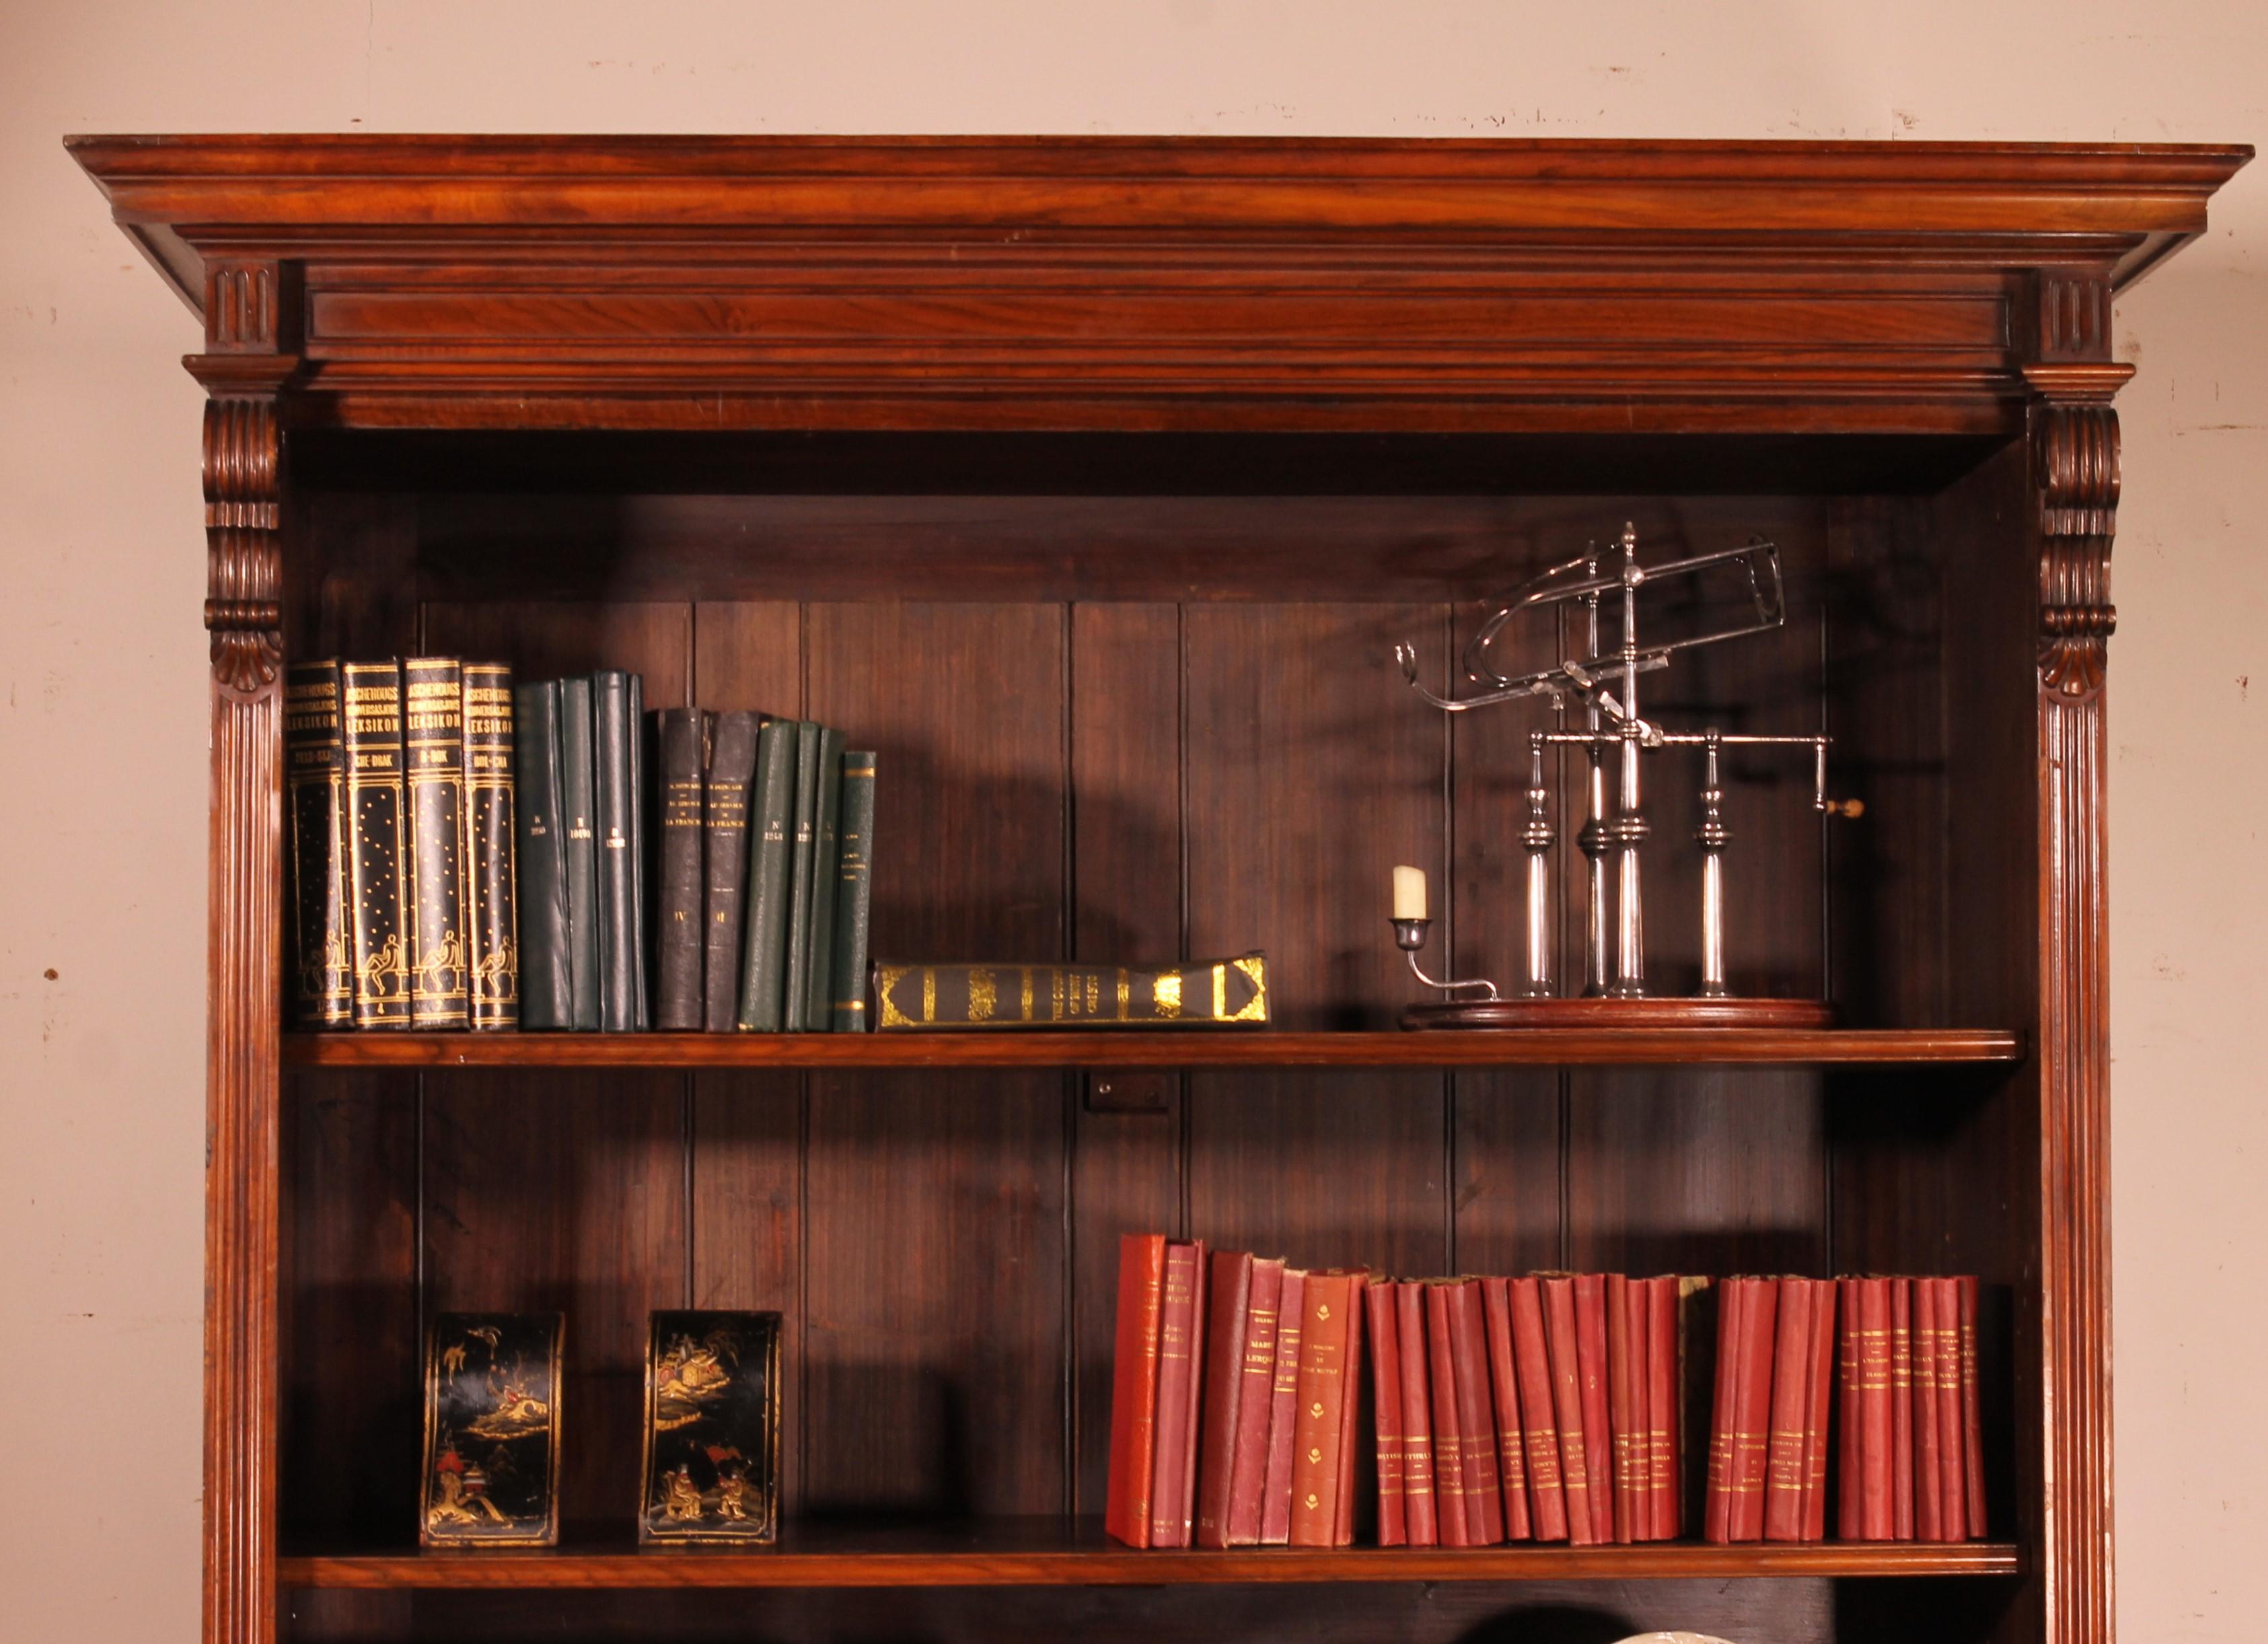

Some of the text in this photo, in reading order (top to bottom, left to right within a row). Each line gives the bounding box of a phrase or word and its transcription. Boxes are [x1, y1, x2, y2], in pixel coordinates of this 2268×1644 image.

[345, 686, 398, 702] ASCHEHOUGS
[408, 682, 460, 698] ASCHEHOUGS
[346, 718, 398, 734] LEKSIKON
[408, 713, 460, 729] LEKSIKON
